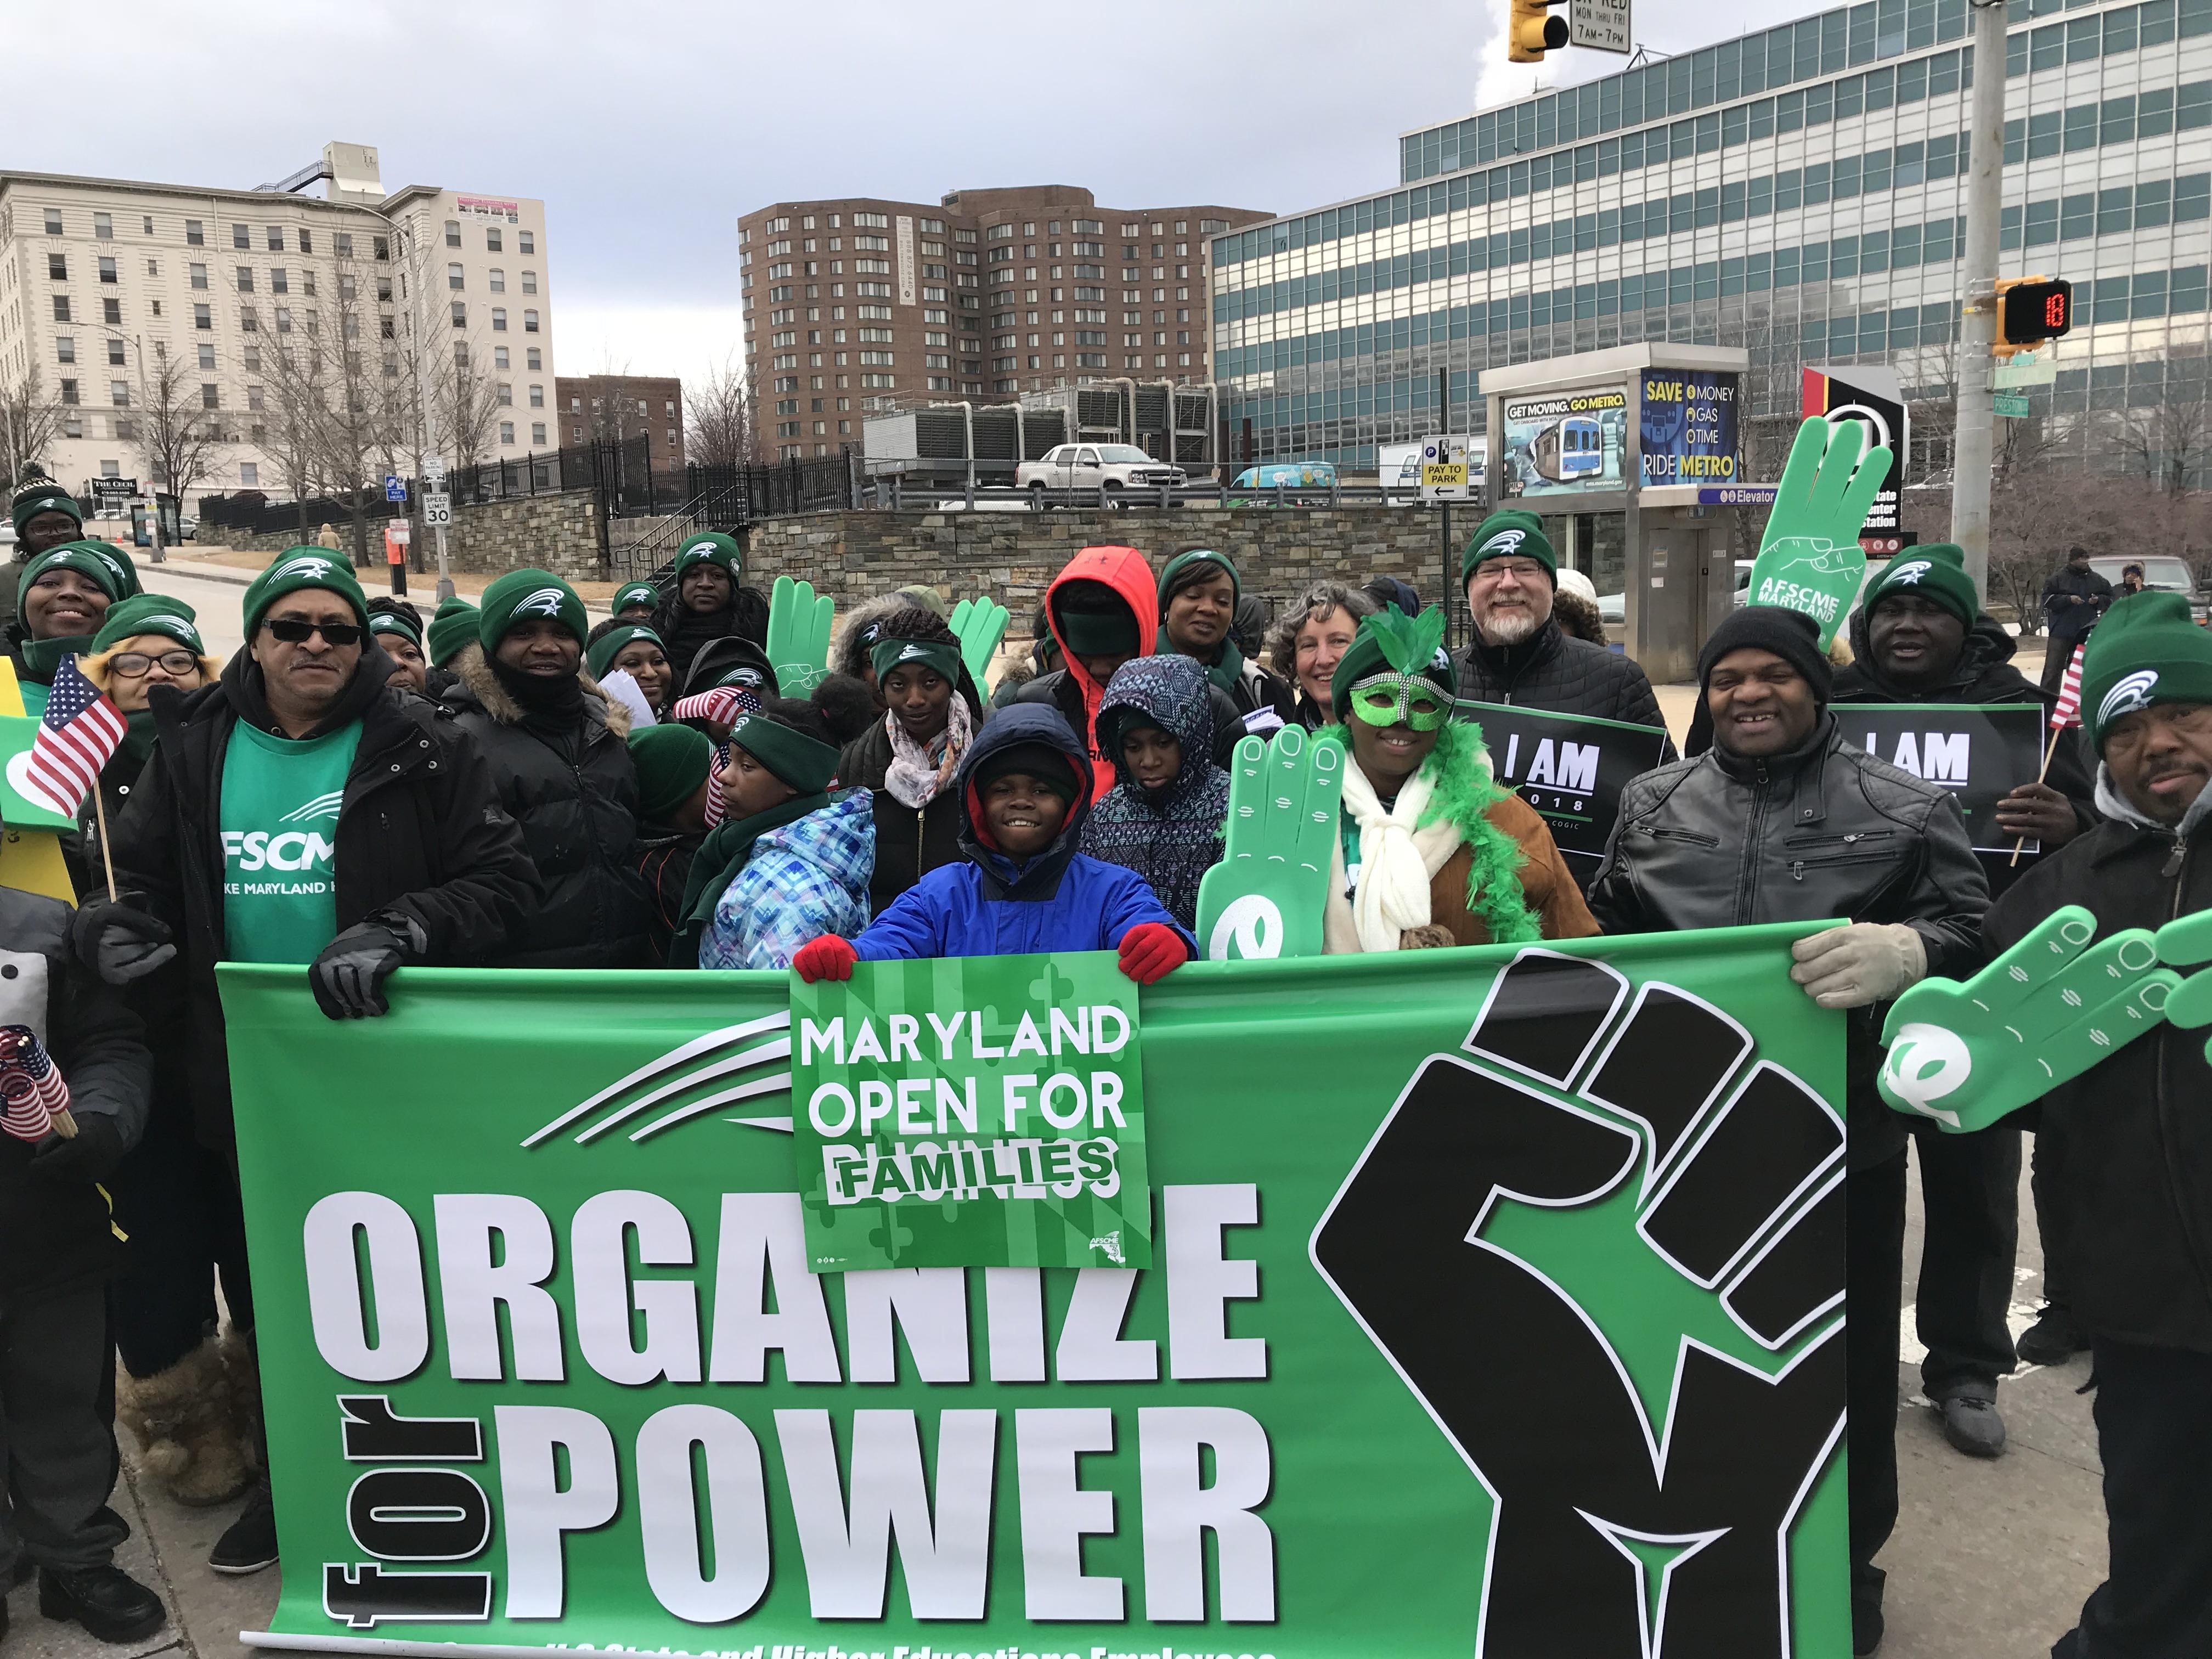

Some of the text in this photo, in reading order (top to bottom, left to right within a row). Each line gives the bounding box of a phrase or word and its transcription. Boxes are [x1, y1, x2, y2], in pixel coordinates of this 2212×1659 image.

[1576, 6, 1625, 26] MON THRU FRI
[2046, 293, 2064, 326] 18
[1646, 380, 1683, 402] SAVE
[1697, 386, 1734, 402] MONEY
[1509, 394, 1624, 417] GET MOVING. GO METRO.
[1696, 408, 1718, 422] GAS
[1696, 429, 1718, 443] TIME
[1429, 466, 1446, 474] PAY
[1448, 465, 1462, 473] TO
[1644, 454, 1734, 476] RIDE METRO
[1432, 475, 1457, 483] PARK
[1737, 490, 1775, 503] Elevator
[1875, 490, 1897, 501] tate
[428, 510, 449, 522] 30
[1868, 504, 1896, 515] enter
[1759, 577, 1839, 614] AFSCME
[1757, 591, 1833, 623] MARYLAND
[1504, 733, 1600, 791] I AM
[1893, 732, 1970, 780] AM
[1531, 794, 1583, 811] 018
[1551, 820, 1579, 830] COGIC
[220, 831, 335, 871] FSCM
[244, 882, 326, 895] MARYLAND
[800, 1005, 1131, 1066] MARYLAND
[808, 1071, 1127, 1138] OPEN FOR
[838, 1141, 1113, 1198] FAMILIES
[1109, 1244, 1119, 1256] 3
[303, 1183, 1267, 1385] ORGANIZE
[323, 1394, 492, 1627] for
[494, 1403, 1276, 1623] POWER
